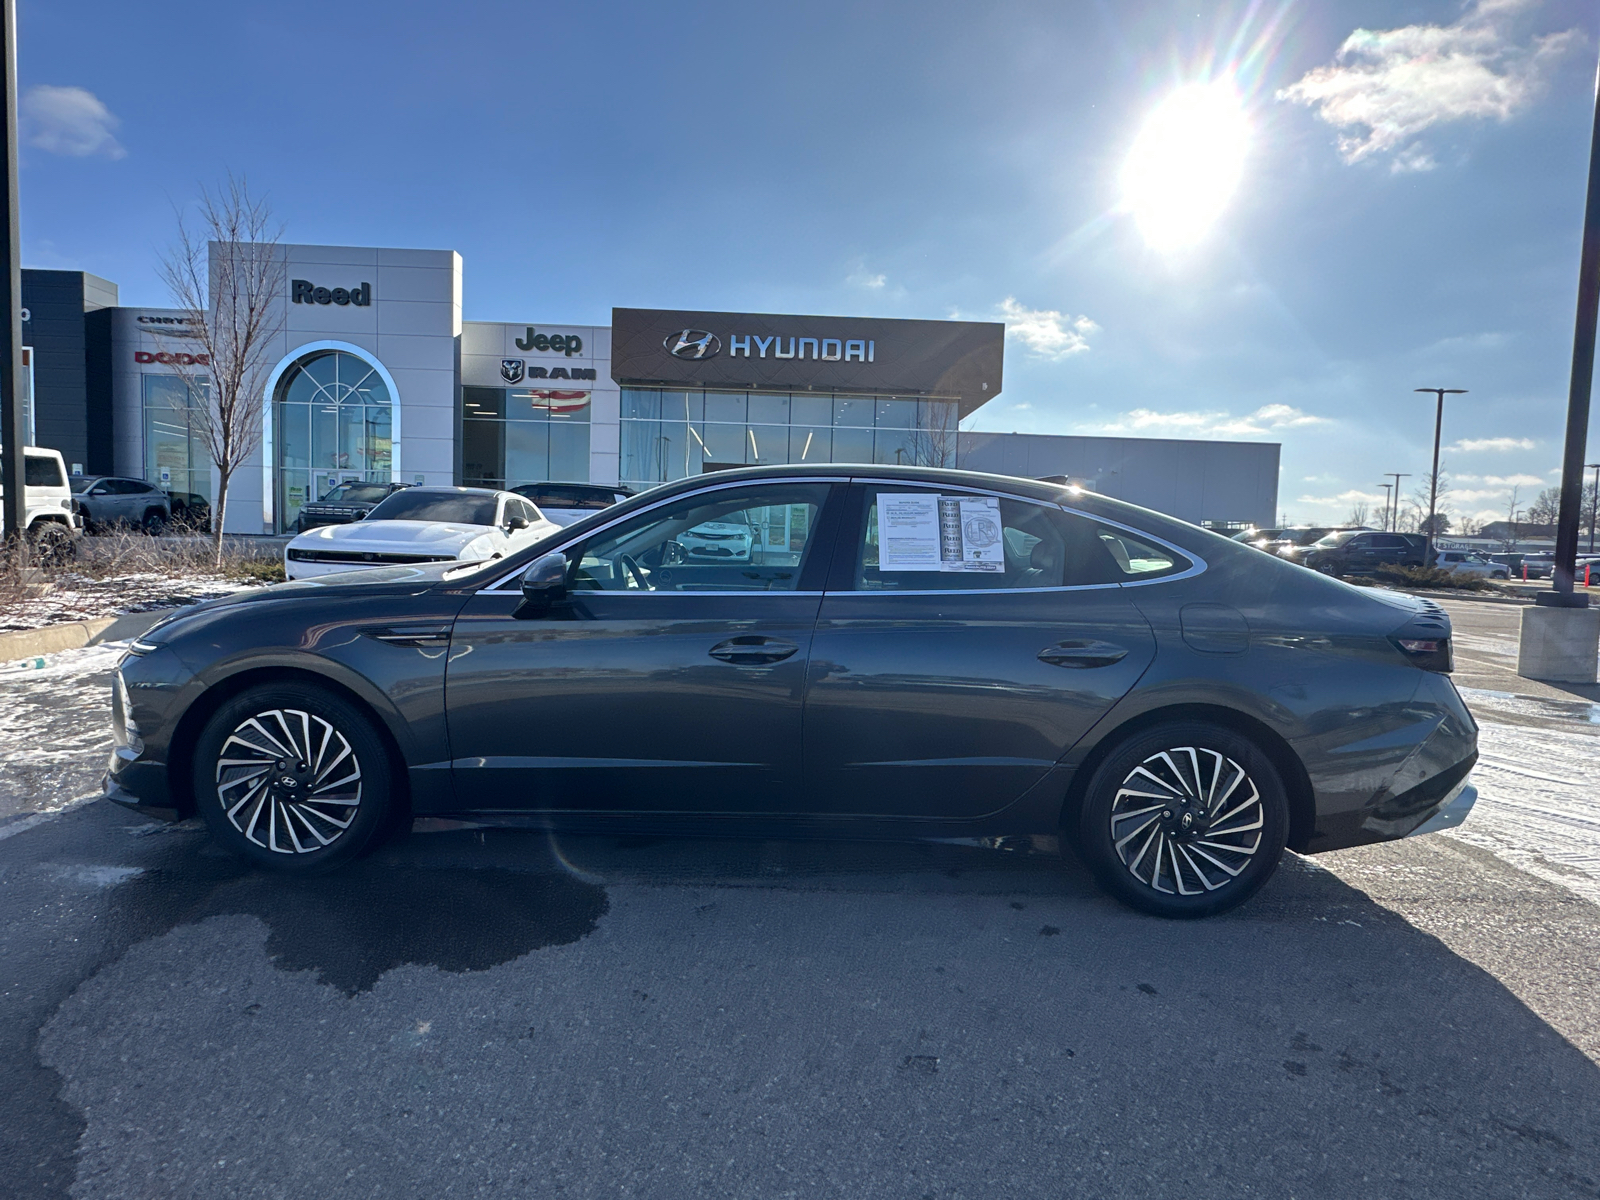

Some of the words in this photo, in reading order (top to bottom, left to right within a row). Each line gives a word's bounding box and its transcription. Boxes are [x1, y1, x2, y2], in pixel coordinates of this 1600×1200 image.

[292, 279, 370, 306] Reed
[515, 327, 582, 356] Jeep
[730, 334, 875, 362] HYUNDAI
[134, 351, 209, 366] DODG
[528, 366, 597, 380] RAM
